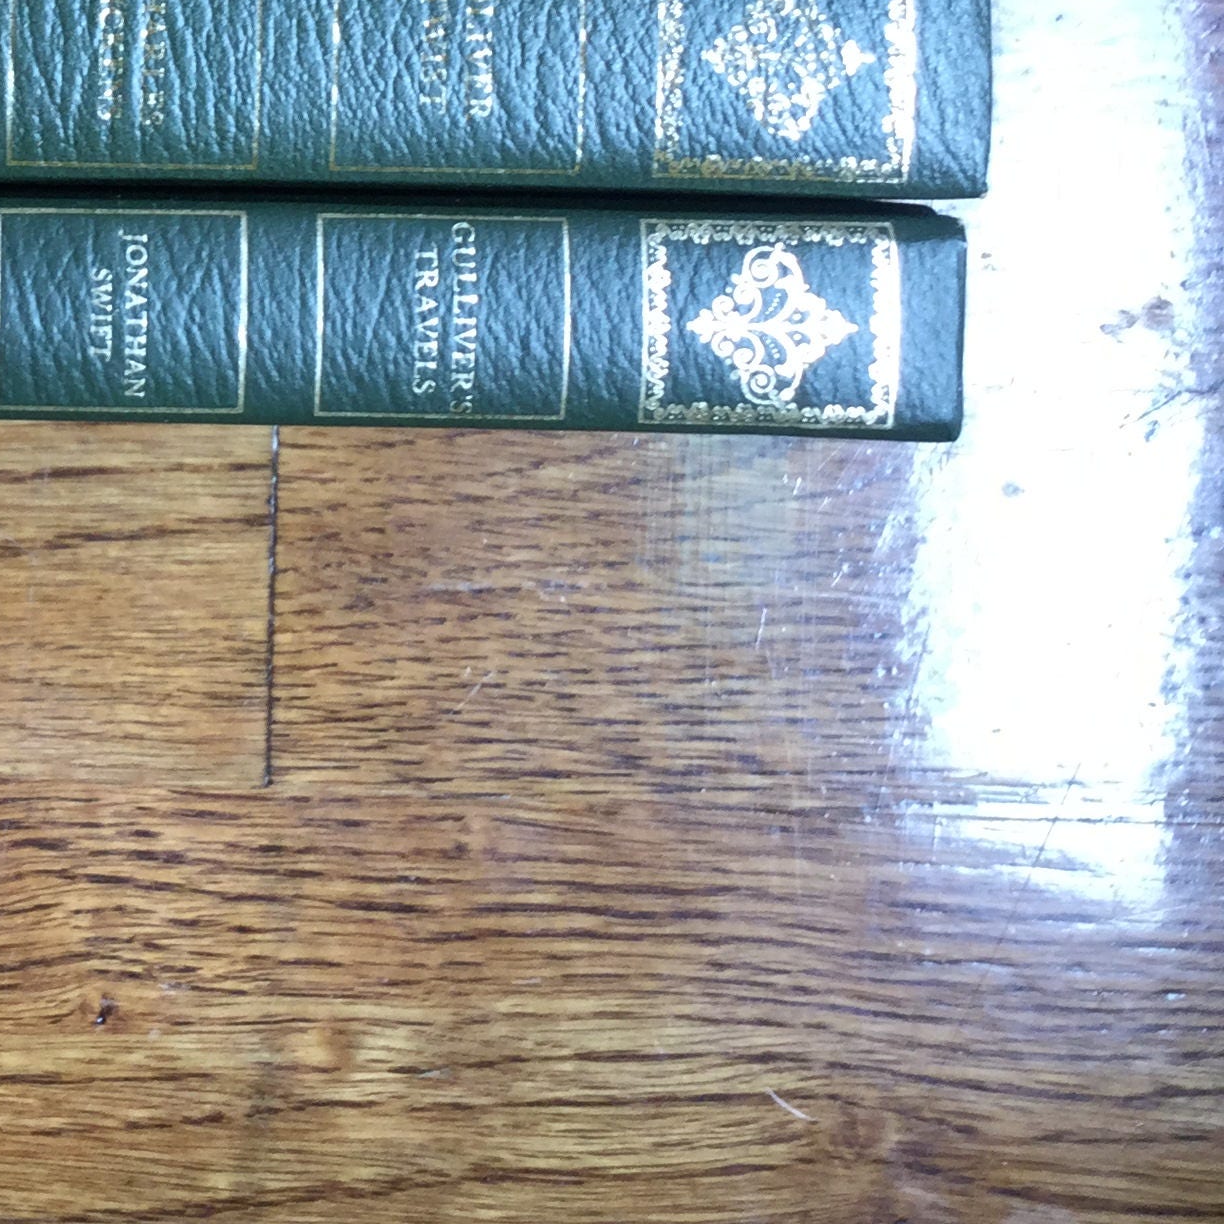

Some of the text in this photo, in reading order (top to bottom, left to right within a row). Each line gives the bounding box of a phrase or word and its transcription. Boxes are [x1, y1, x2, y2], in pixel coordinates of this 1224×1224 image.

[89, 268, 112, 362] SWIFT
[118, 229, 148, 398] JONATHAN
[412, 241, 439, 395] TRAVELS
[450, 222, 479, 414] GULLIVER'S
